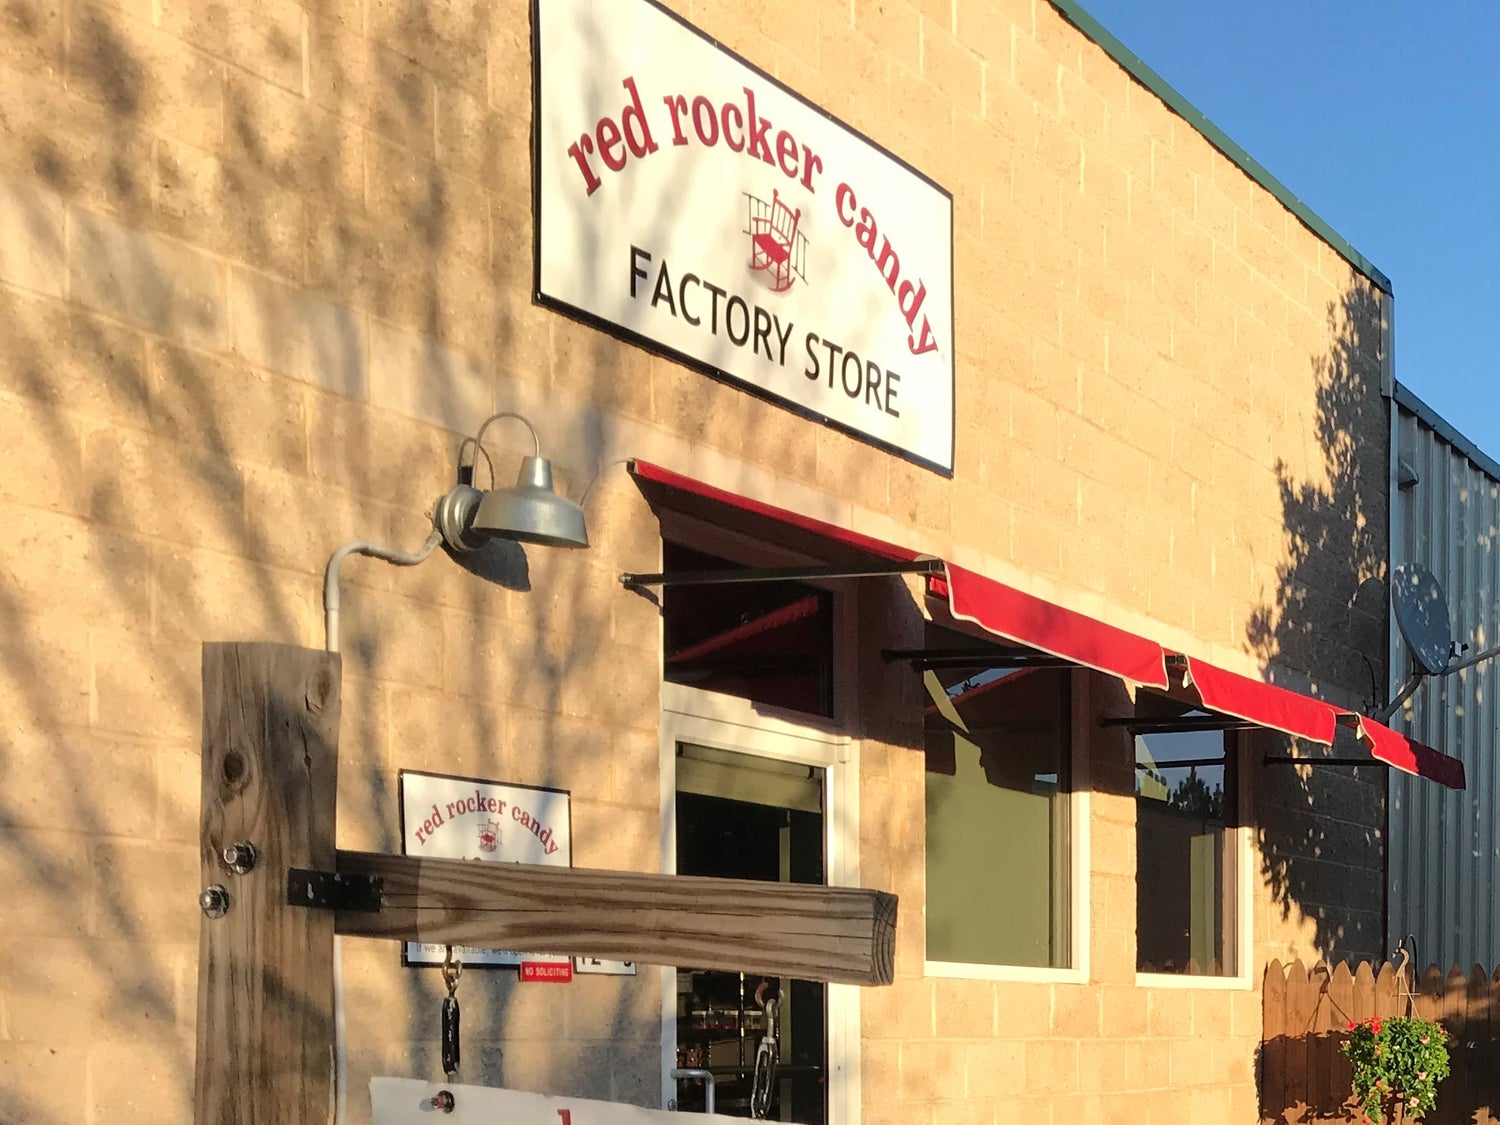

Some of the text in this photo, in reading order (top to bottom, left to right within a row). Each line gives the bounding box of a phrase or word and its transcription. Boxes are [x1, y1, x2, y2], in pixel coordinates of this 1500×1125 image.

[567, 76, 939, 356] red rocker candy
[629, 244, 901, 418] FACTORY STORE
[414, 790, 559, 855] red rocker candy
[424, 945, 437, 953] we
[524, 966, 569, 978] NO SOLICITING
